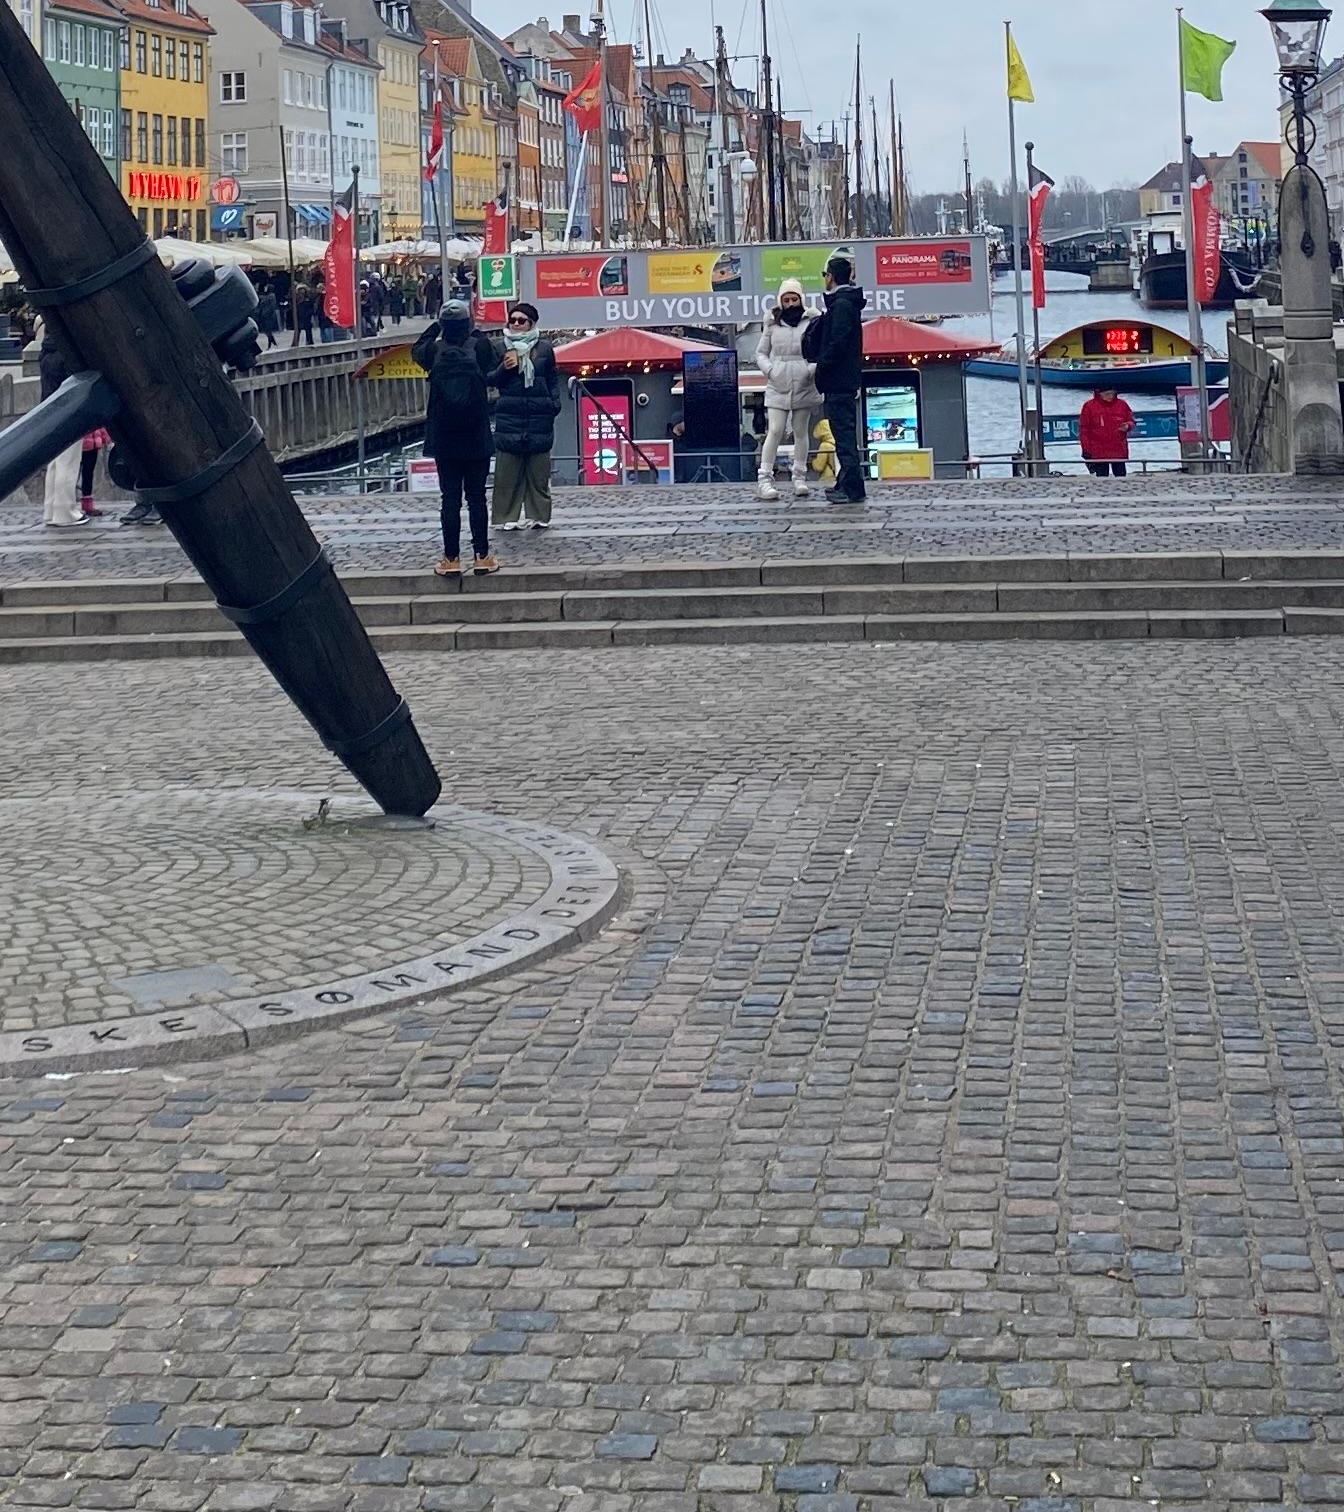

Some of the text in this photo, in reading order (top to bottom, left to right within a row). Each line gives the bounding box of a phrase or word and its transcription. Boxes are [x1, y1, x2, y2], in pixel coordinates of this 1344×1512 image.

[129, 171, 184, 200] NYHAVN
[891, 254, 938, 265] PANORAMA
[606, 289, 906, 321] BUY YOUR TICTS ERE
[1056, 345, 1069, 358] 2
[1168, 343, 1175, 356] 1
[376, 364, 385, 377] 3
[258, 928, 540, 1018] SØMAND
[539, 885, 600, 918] DER
